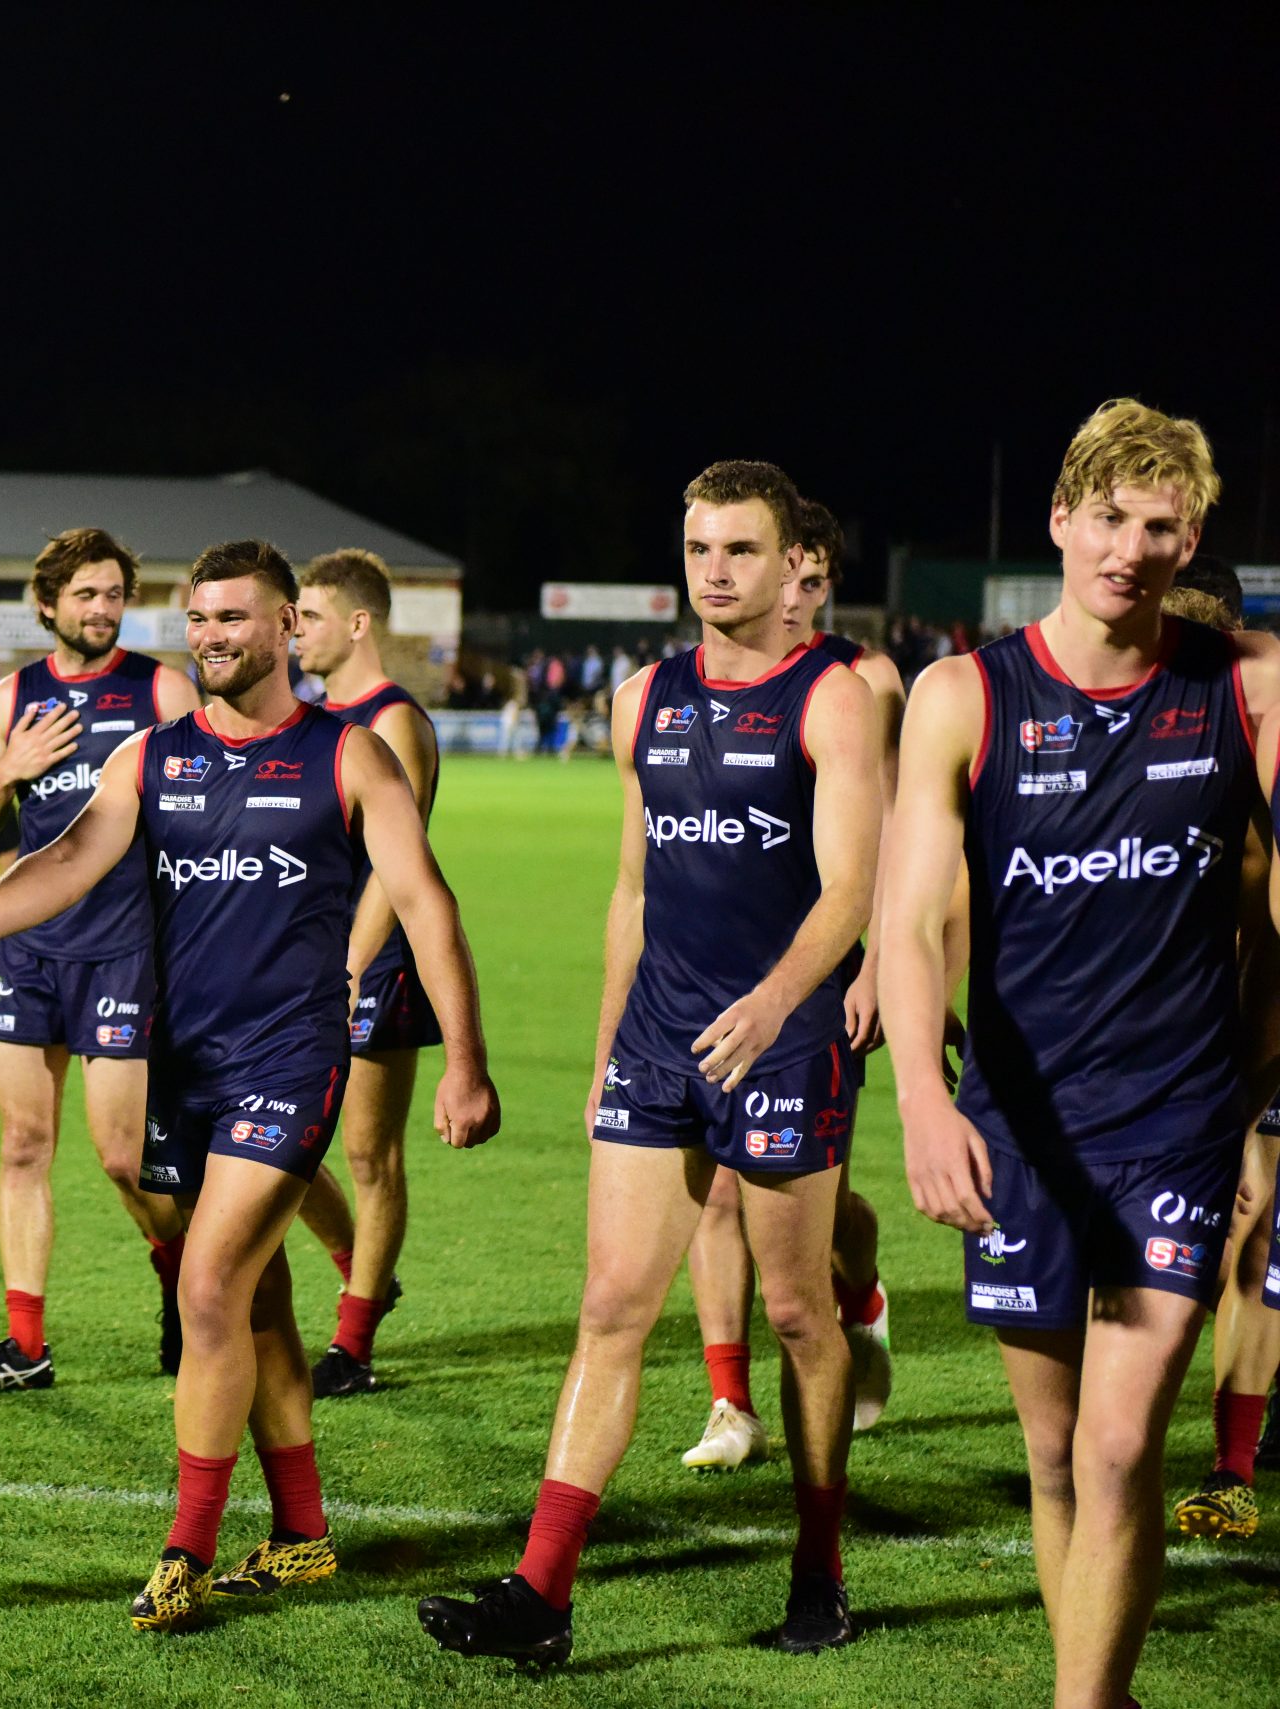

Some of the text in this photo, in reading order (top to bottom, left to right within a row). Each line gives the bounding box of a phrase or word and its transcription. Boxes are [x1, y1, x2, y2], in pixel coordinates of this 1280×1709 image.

[649, 748, 678, 757] PARADISE
[725, 754, 774, 766] schiavello
[1045, 781, 1082, 791] MAZDA
[161, 795, 193, 803] PARADISE
[645, 806, 745, 848] Apelle
[157, 849, 263, 890] Apelle
[1003, 837, 1180, 895] Apelle
[117, 1003, 140, 1015] IWS
[267, 1099, 298, 1115] IWS
[774, 1098, 804, 1112] IWS
[601, 1118, 625, 1128] MAZDA
[234, 1123, 251, 1139] S
[252, 1132, 277, 1144] Statewide
[749, 1133, 765, 1151] S
[1150, 1241, 1173, 1264] S
[972, 1284, 1018, 1298] PARADISE
[996, 1299, 1033, 1309] MAZDA
